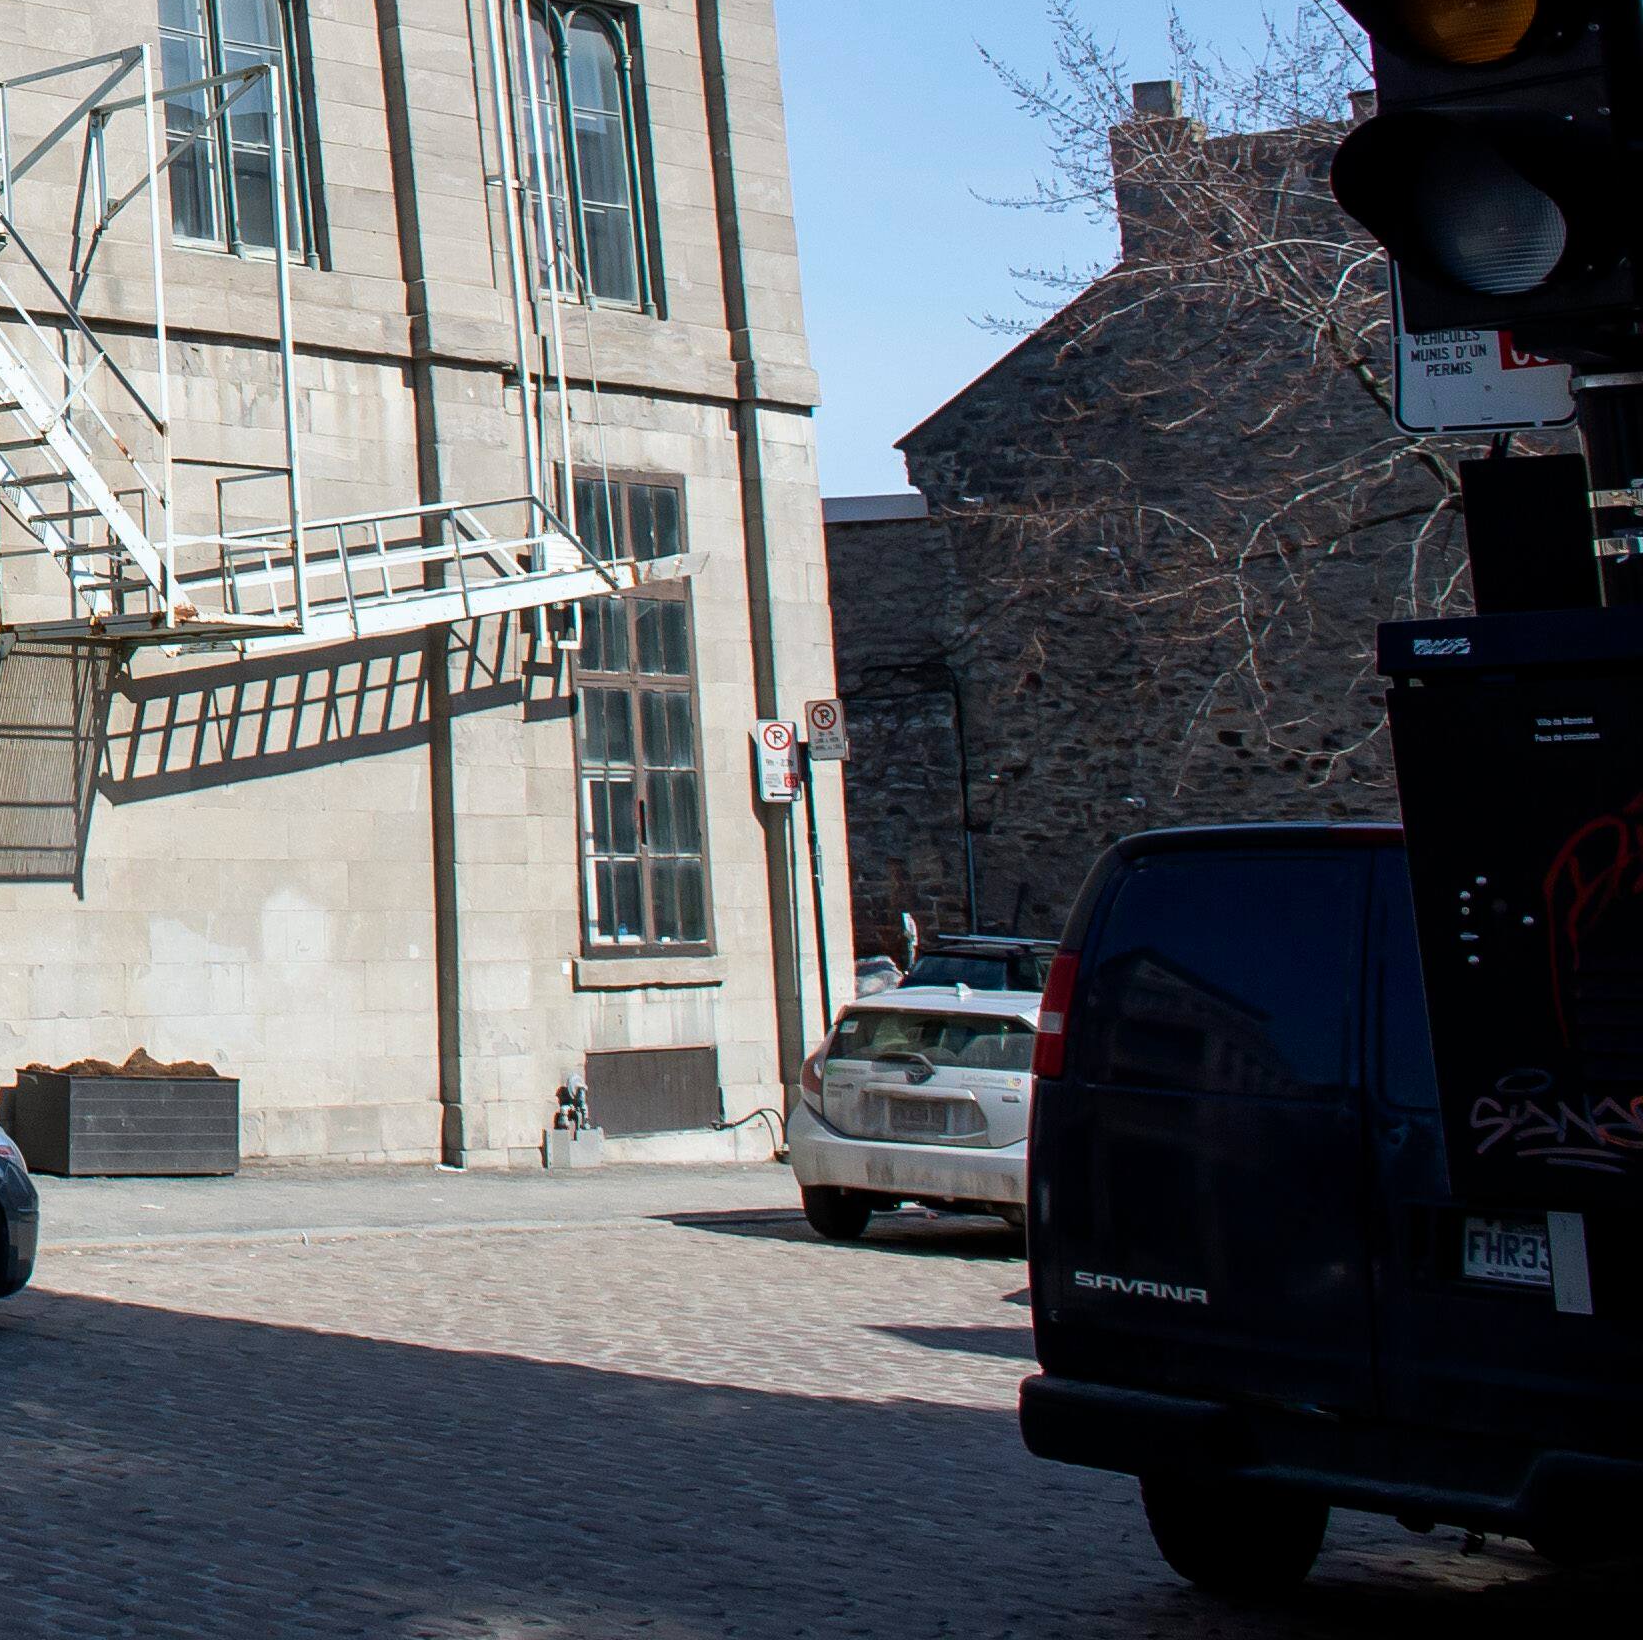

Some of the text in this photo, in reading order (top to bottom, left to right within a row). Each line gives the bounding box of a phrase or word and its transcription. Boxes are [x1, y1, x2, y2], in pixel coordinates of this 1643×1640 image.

[1410, 343, 1487, 363] MUNIS D'UN
[1426, 361, 1473, 377] PERMIS
[1074, 1270, 1211, 1306] SAVANA
